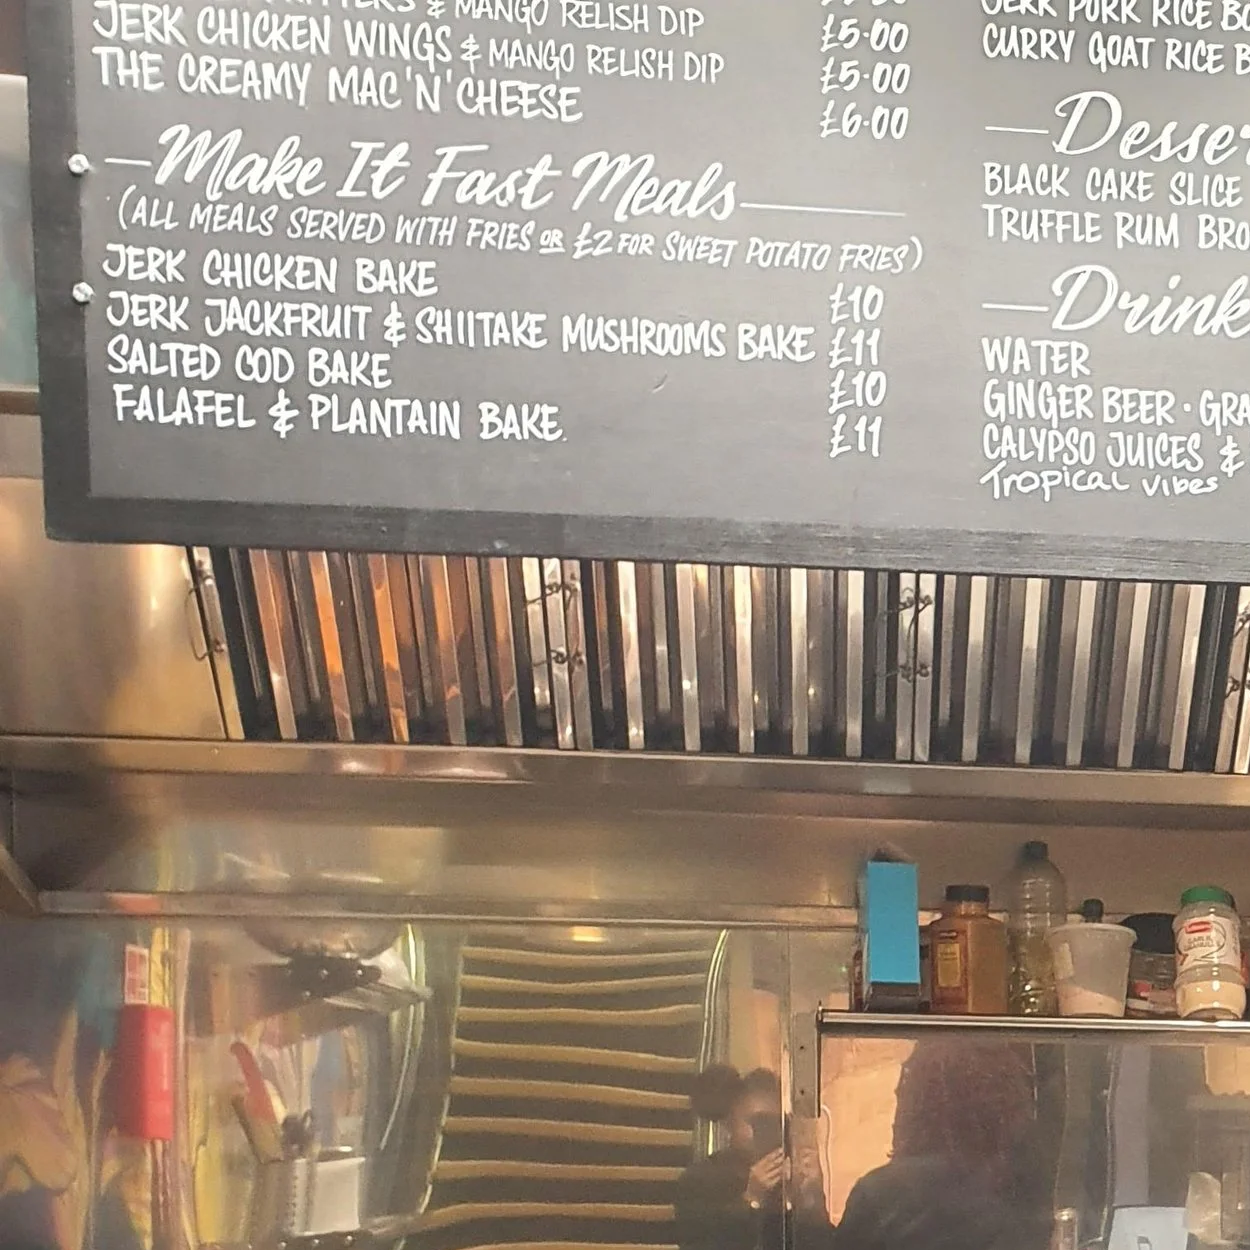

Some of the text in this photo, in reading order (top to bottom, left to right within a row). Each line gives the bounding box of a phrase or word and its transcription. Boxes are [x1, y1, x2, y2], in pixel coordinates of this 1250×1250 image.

[454, 0, 549, 34] MANGO
[560, 0, 649, 33] RELISH
[657, 6, 704, 37] DIP
[1153, 0, 1212, 30] RICE
[93, 0, 187, 46] JERK
[197, 6, 330, 54] CHICKEN
[344, 20, 452, 73] WINGS
[489, 39, 574, 80] MANGO
[586, 44, 673, 81] RELISH
[684, 51, 724, 83] DIP
[983, 23, 1075, 62] CURRY
[1089, 31, 1155, 72] GOAT
[1165, 39, 1224, 74] RICE
[92, 47, 164, 92] THE
[405, 65, 453, 112] 'N'
[155, 124, 736, 222] Make It Fast Meals
[983, 162, 1243, 207] BLACK CAKE SLICE
[190, 203, 278, 236] MEALS
[287, 207, 385, 243] SERVED
[395, 215, 457, 245] WITH
[466, 218, 535, 251] FRIES
[539, 229, 565, 253] OR
[573, 222, 612, 259] £2
[618, 233, 654, 255] FOR
[662, 231, 738, 267] SWEET
[746, 237, 831, 270] POTATO
[982, 204, 1102, 243] TRUFFLE
[1114, 212, 1179, 248] RUM
[103, 243, 438, 297] JERK CHICKEN BAKE
[107, 291, 189, 331] JERK
[205, 296, 372, 340] JACKFRUIT
[415, 306, 547, 348] SHIITAKE
[563, 313, 726, 357] MUSHROOMS
[738, 323, 815, 362] BAKE
[830, 283, 883, 324] £10
[107, 333, 391, 388] SALTED COD BAKE
[829, 327, 880, 368] £11
[982, 336, 1090, 378] WATER
[113, 384, 256, 427] FALAFEL
[308, 394, 460, 439] PLANTAIN
[829, 370, 886, 413] £10
[984, 379, 1093, 428] GINGER
[1102, 387, 1175, 425] BEER
[830, 414, 881, 457] £11
[983, 423, 1095, 465] CALYPSO
[1107, 432, 1203, 471] JUICES
[980, 460, 1130, 502] Tropical
